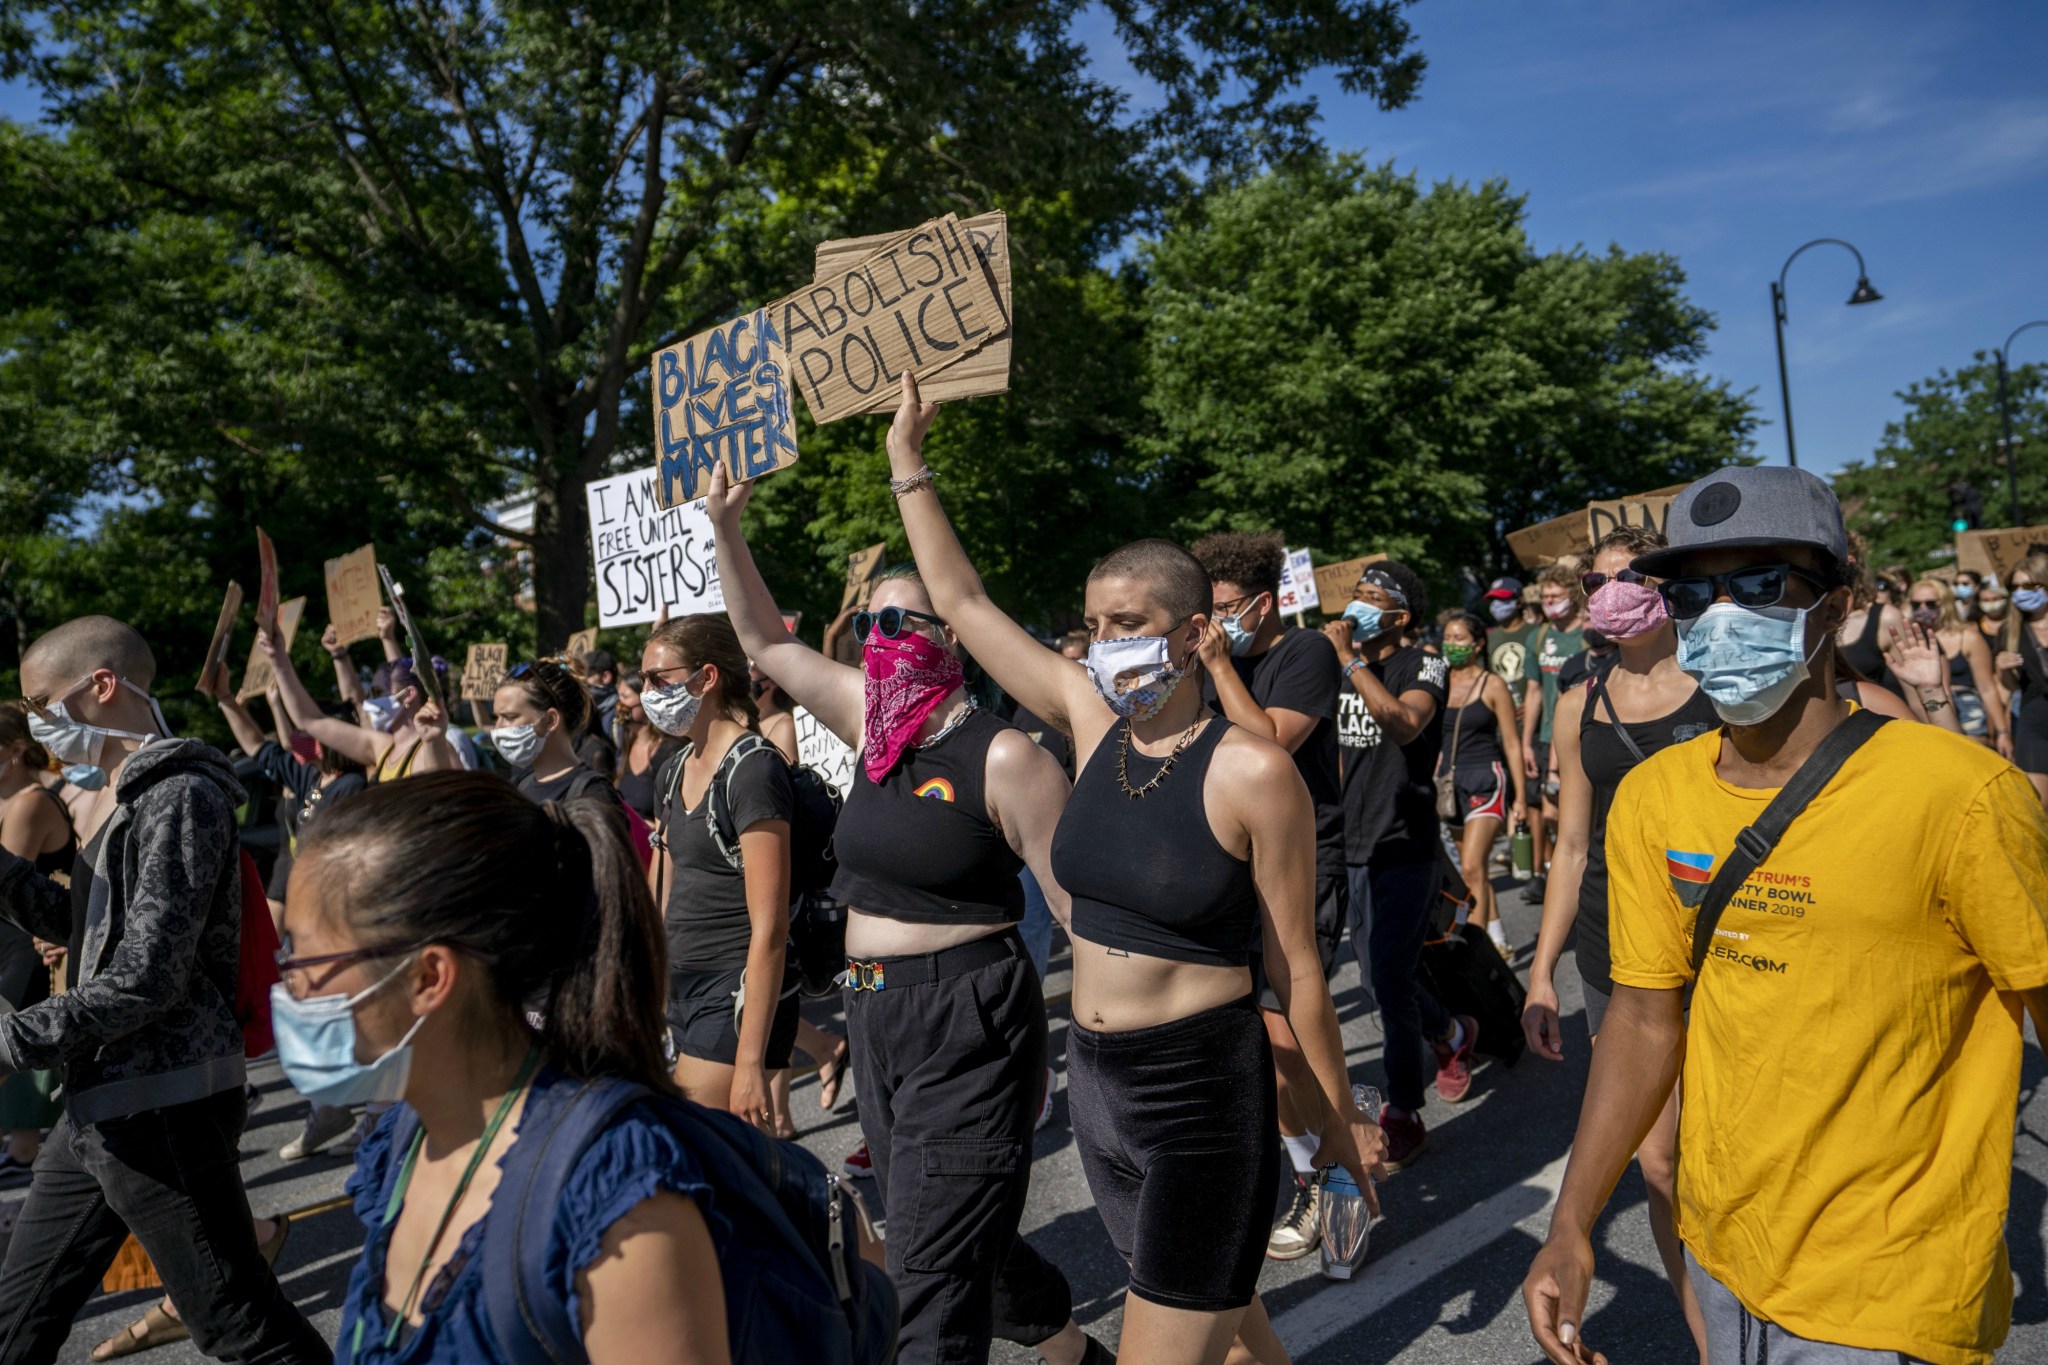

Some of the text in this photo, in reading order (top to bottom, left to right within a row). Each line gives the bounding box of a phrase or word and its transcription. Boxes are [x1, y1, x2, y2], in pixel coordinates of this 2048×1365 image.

[784, 220, 971, 353] ABOLISH
[659, 309, 783, 409] BLACK
[800, 276, 990, 410] POLICE
[660, 361, 784, 456] LIVES
[661, 390, 797, 506] MATTER
[593, 476, 657, 525] I AM
[598, 507, 692, 559] FREE UNTIL
[703, 538, 716, 553] AR
[603, 537, 706, 617] SISTERS
[1337, 713, 1382, 737] LAC
[1338, 692, 1371, 715] TH
[1737, 884, 1816, 905] PTY BOWL
[1747, 871, 1812, 888] CTRUM'S
[1727, 897, 1806, 918] NNER 2019
[1714, 928, 1750, 940] ENTED BY
